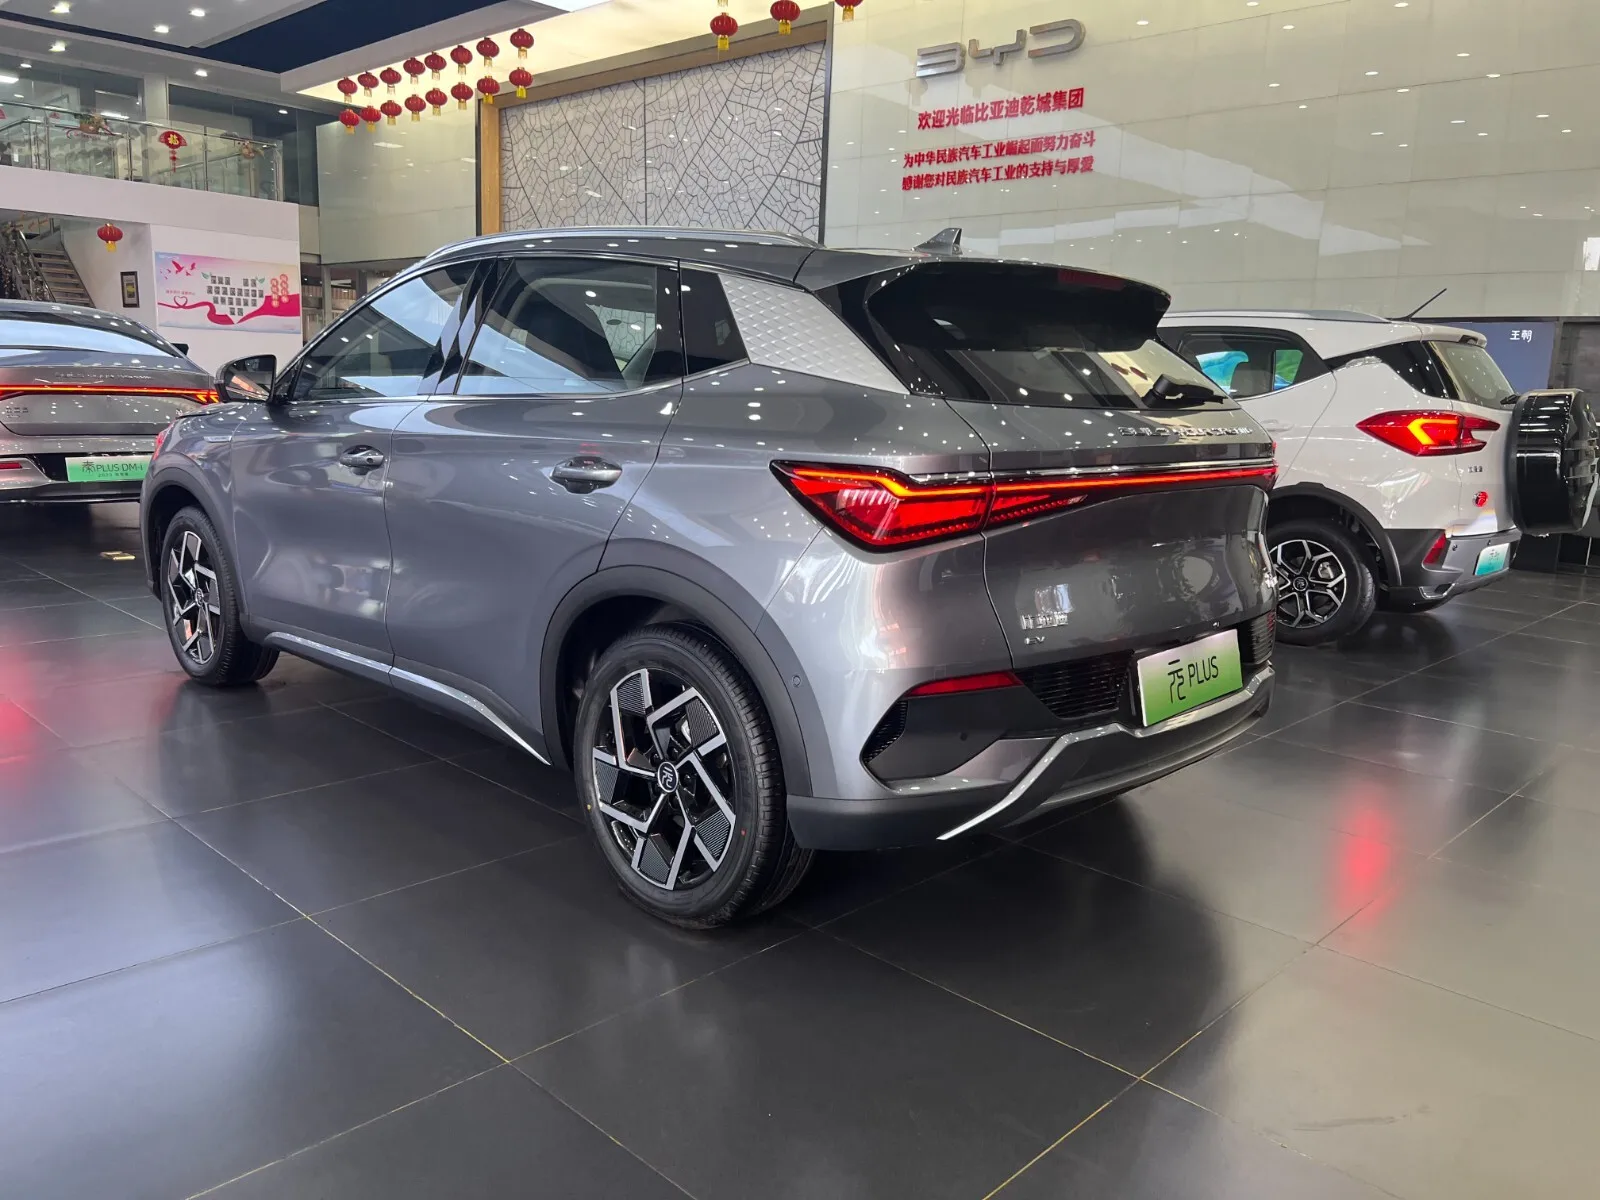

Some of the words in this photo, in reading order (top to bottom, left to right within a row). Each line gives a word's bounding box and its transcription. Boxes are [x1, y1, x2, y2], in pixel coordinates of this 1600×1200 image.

[915, 18, 1086, 78] BYD
[917, 87, 1085, 130] 欢迎光临比亚迪乾城集团
[903, 130, 1096, 168] 为中华民族汽车工业崛起而努力奋斗
[902, 155, 1095, 191] 感谢您对民族汽车工业的支持与厚爱
